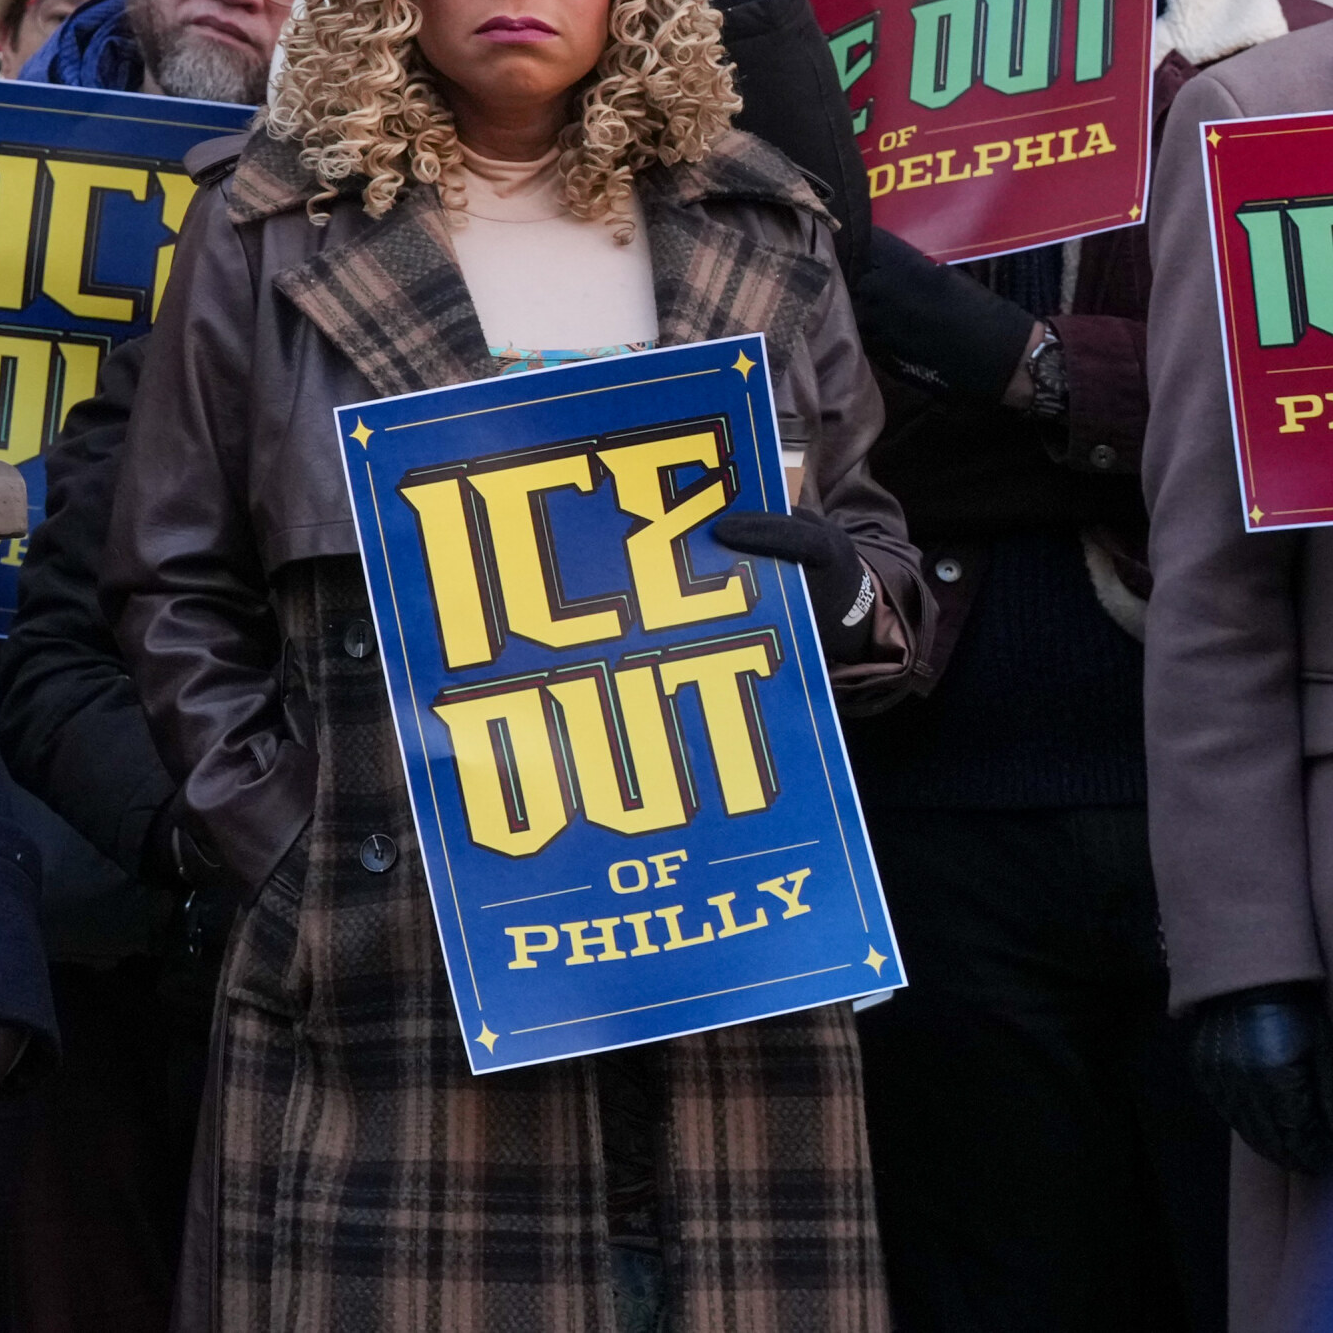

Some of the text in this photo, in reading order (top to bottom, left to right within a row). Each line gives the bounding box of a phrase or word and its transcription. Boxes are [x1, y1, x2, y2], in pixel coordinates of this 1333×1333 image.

[867, 122, 1117, 199] DELPHIA
[878, 125, 917, 153] OF
[396, 413, 761, 670] ICE
[430, 625, 785, 858] OUT
[608, 848, 690, 895] OF
[504, 867, 815, 970] PHILLY
